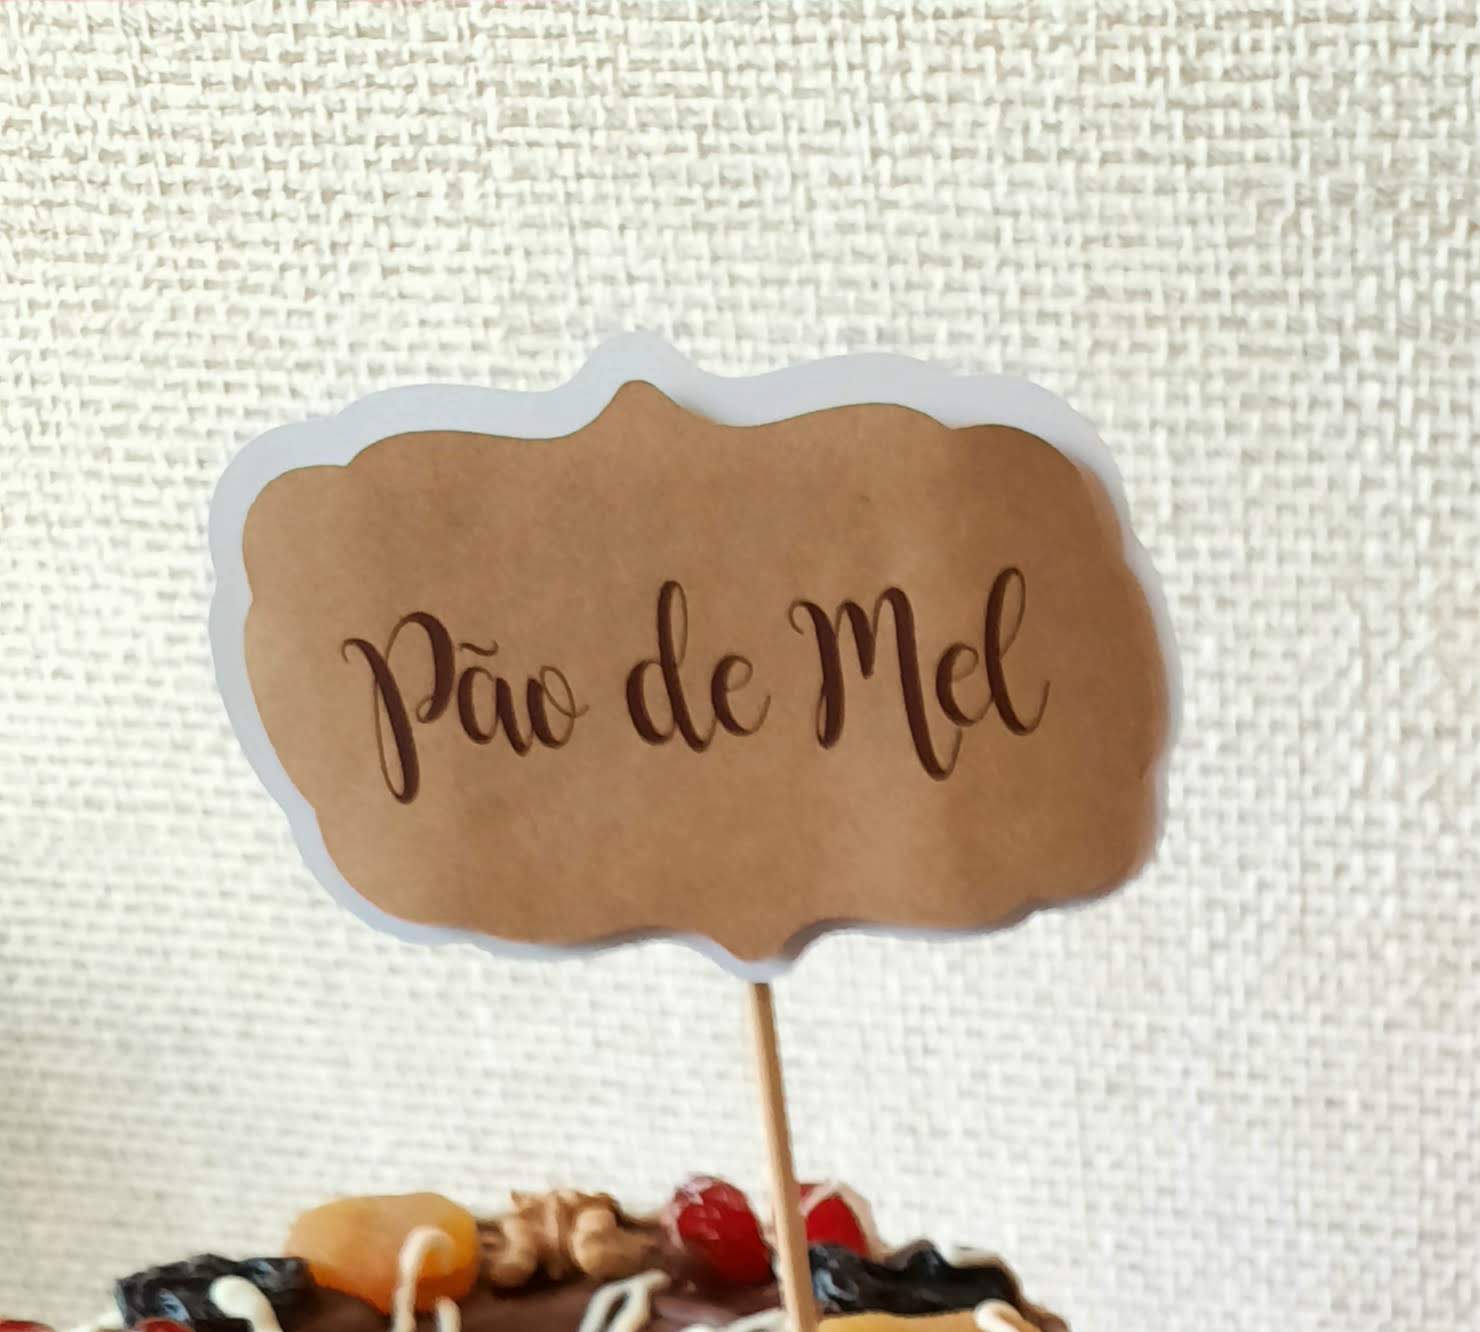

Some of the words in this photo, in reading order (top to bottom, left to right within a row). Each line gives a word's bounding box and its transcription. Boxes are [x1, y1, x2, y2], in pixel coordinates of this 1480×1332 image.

[341, 610, 590, 805] Pão
[624, 579, 771, 754] de
[787, 566, 1050, 782] Mel
